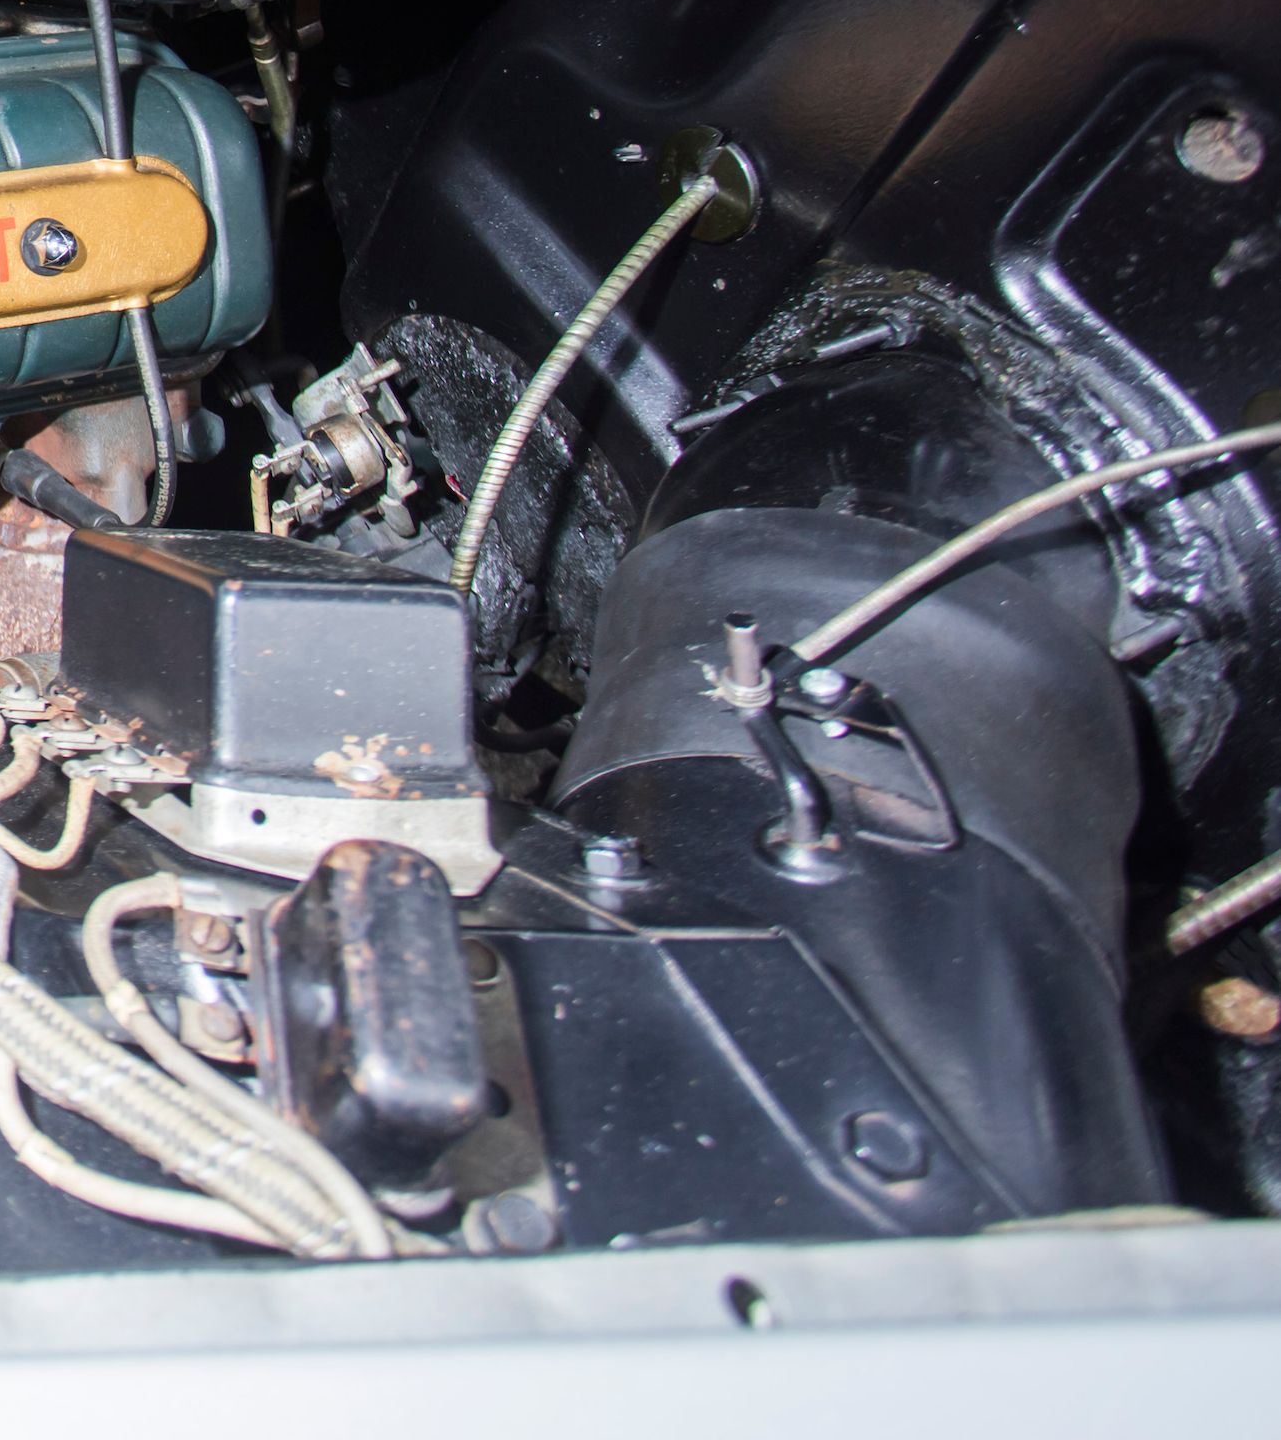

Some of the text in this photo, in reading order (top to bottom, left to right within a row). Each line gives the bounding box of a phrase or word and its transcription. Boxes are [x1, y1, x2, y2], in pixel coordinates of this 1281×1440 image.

[149, 400, 164, 429] CORE
[156, 440, 169, 459] RFI
[150, 461, 170, 527] SUPPRESSION
